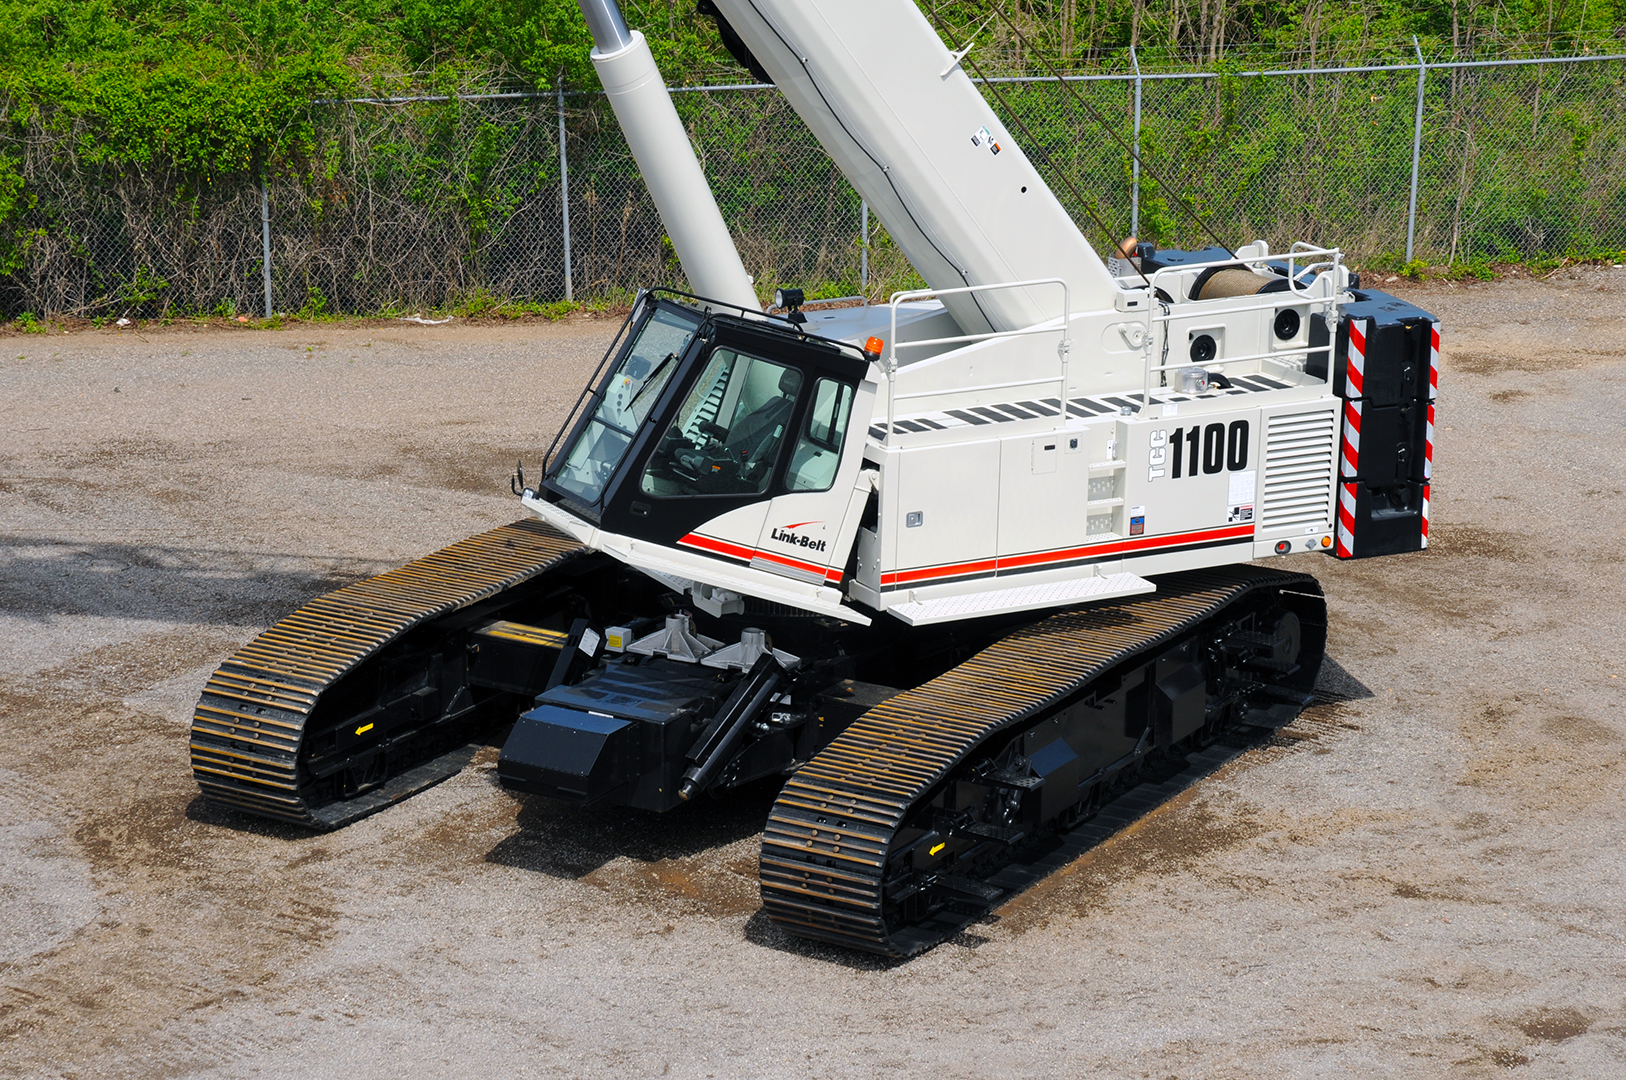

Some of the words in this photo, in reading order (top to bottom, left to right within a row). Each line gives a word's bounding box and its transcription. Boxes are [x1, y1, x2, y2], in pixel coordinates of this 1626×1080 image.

[1148, 429, 1167, 482] TCC
[1169, 419, 1249, 479] 1100
[771, 527, 827, 552] Link-Belt
